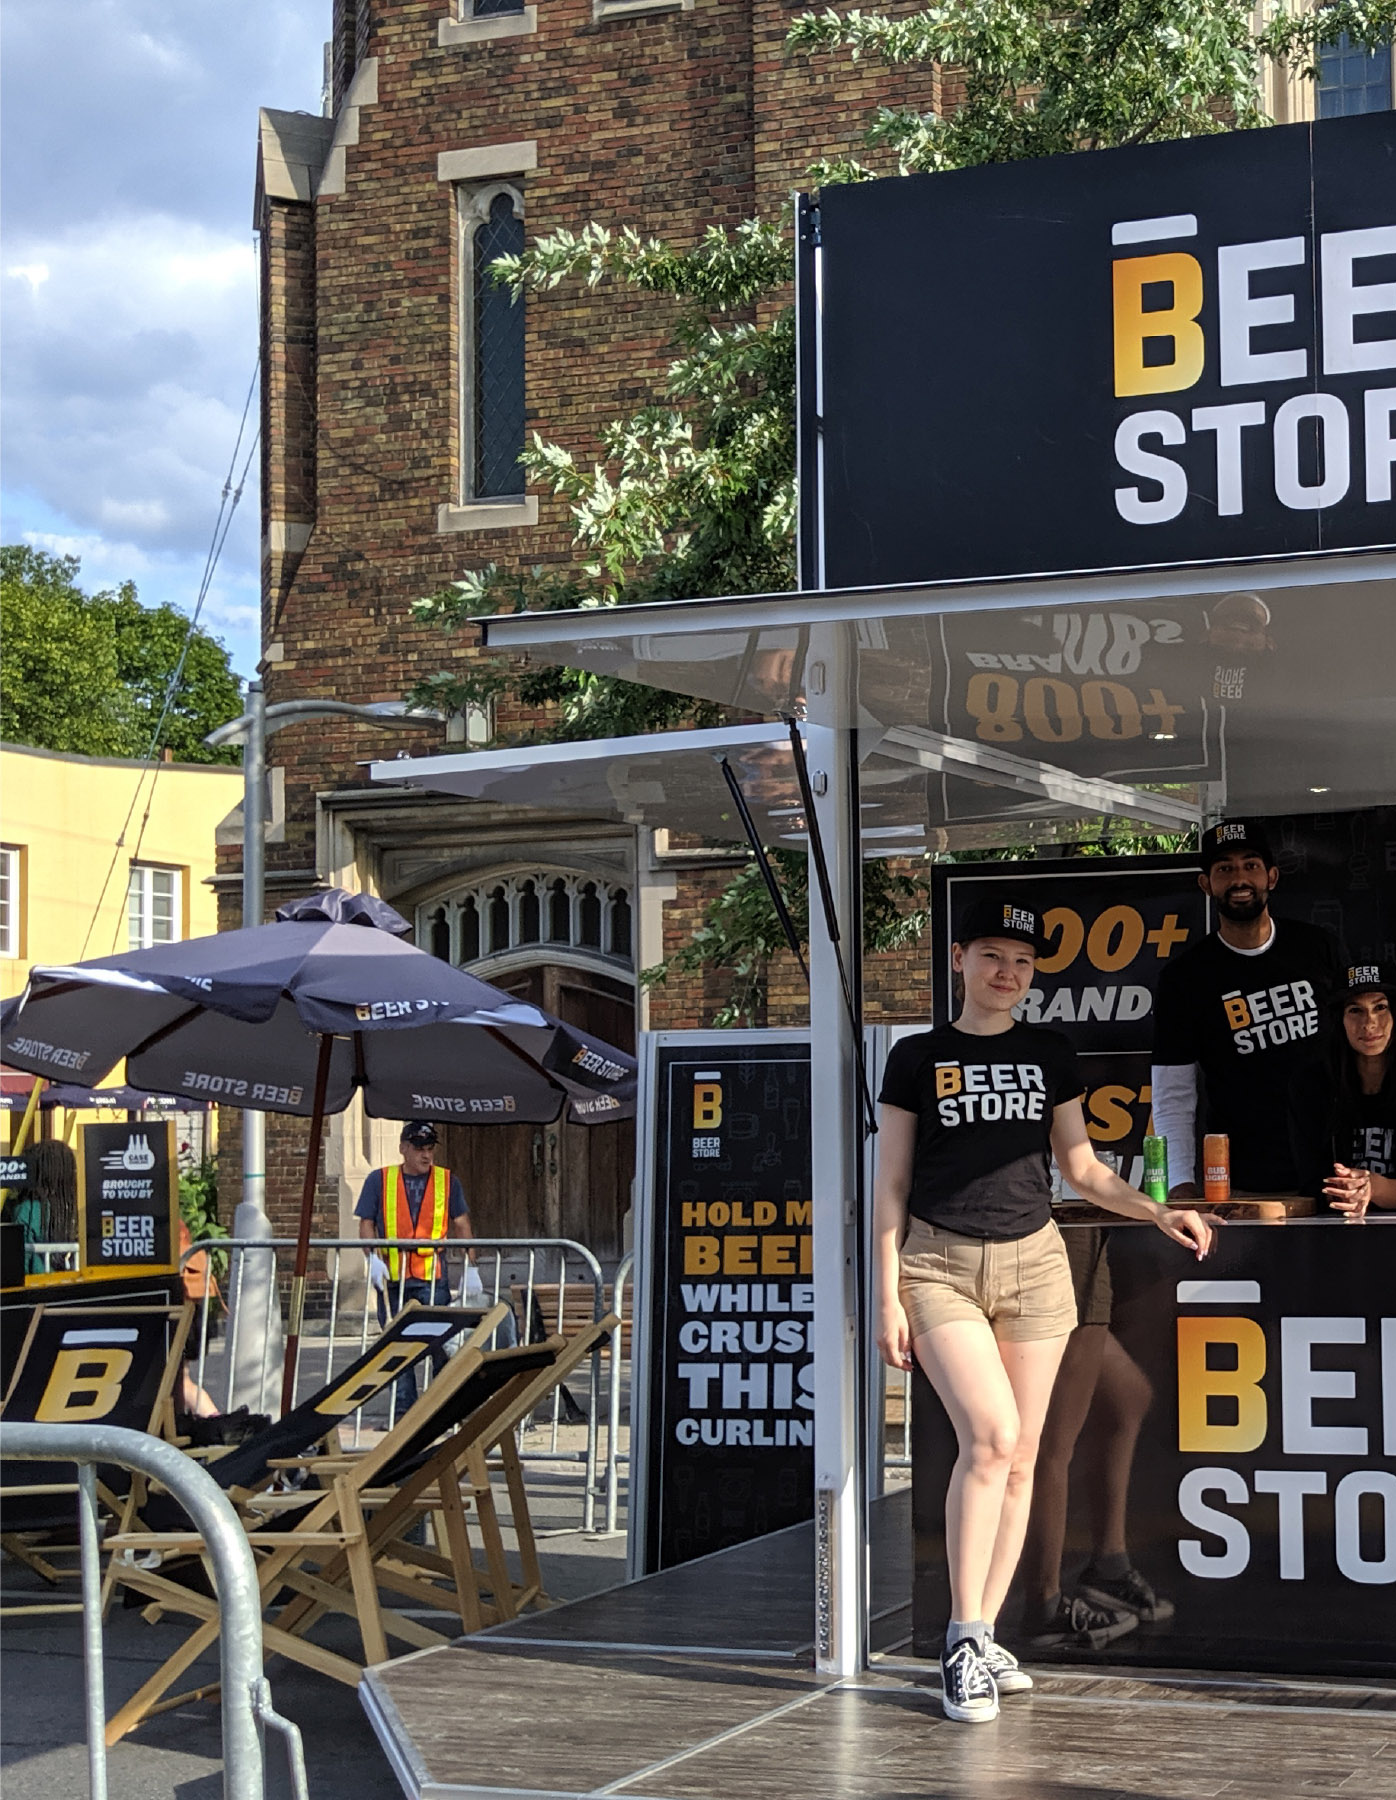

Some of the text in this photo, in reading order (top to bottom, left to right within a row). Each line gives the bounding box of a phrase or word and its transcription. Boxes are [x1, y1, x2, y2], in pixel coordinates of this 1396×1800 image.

[1216, 824, 1246, 837] BEER
[1217, 832, 1247, 845] STORE
[1003, 905, 1035, 924] BEER
[1003, 918, 1035, 935] STORE
[1034, 904, 1190, 974] 00+
[1348, 966, 1380, 980] BEER
[1348, 975, 1381, 988] STORE
[1011, 985, 1154, 1023] RAND
[1222, 980, 1318, 1030] BEER
[1233, 1010, 1319, 1054] STORE
[572, 1046, 604, 1073] BEER
[935, 1062, 1046, 1099] BEER
[693, 1083, 723, 1130] B
[938, 1091, 1046, 1127] STORE
[692, 1136, 721, 1148] BEER
[692, 1148, 721, 1158] STORE
[0, 1160, 27, 1174] 00+
[0, 1172, 27, 1180] ANDS
[1207, 1166, 1226, 1175] BUD
[102, 1179, 153, 1189] BROUGHT
[102, 1188, 154, 1199] TO YOU BY
[681, 1200, 812, 1227] HOLD M
[102, 1214, 155, 1238] BEER
[102, 1238, 155, 1258] STORE
[680, 1283, 814, 1313] WHILE
[35, 1348, 135, 1422] B
[675, 1417, 813, 1447] CURLIN
